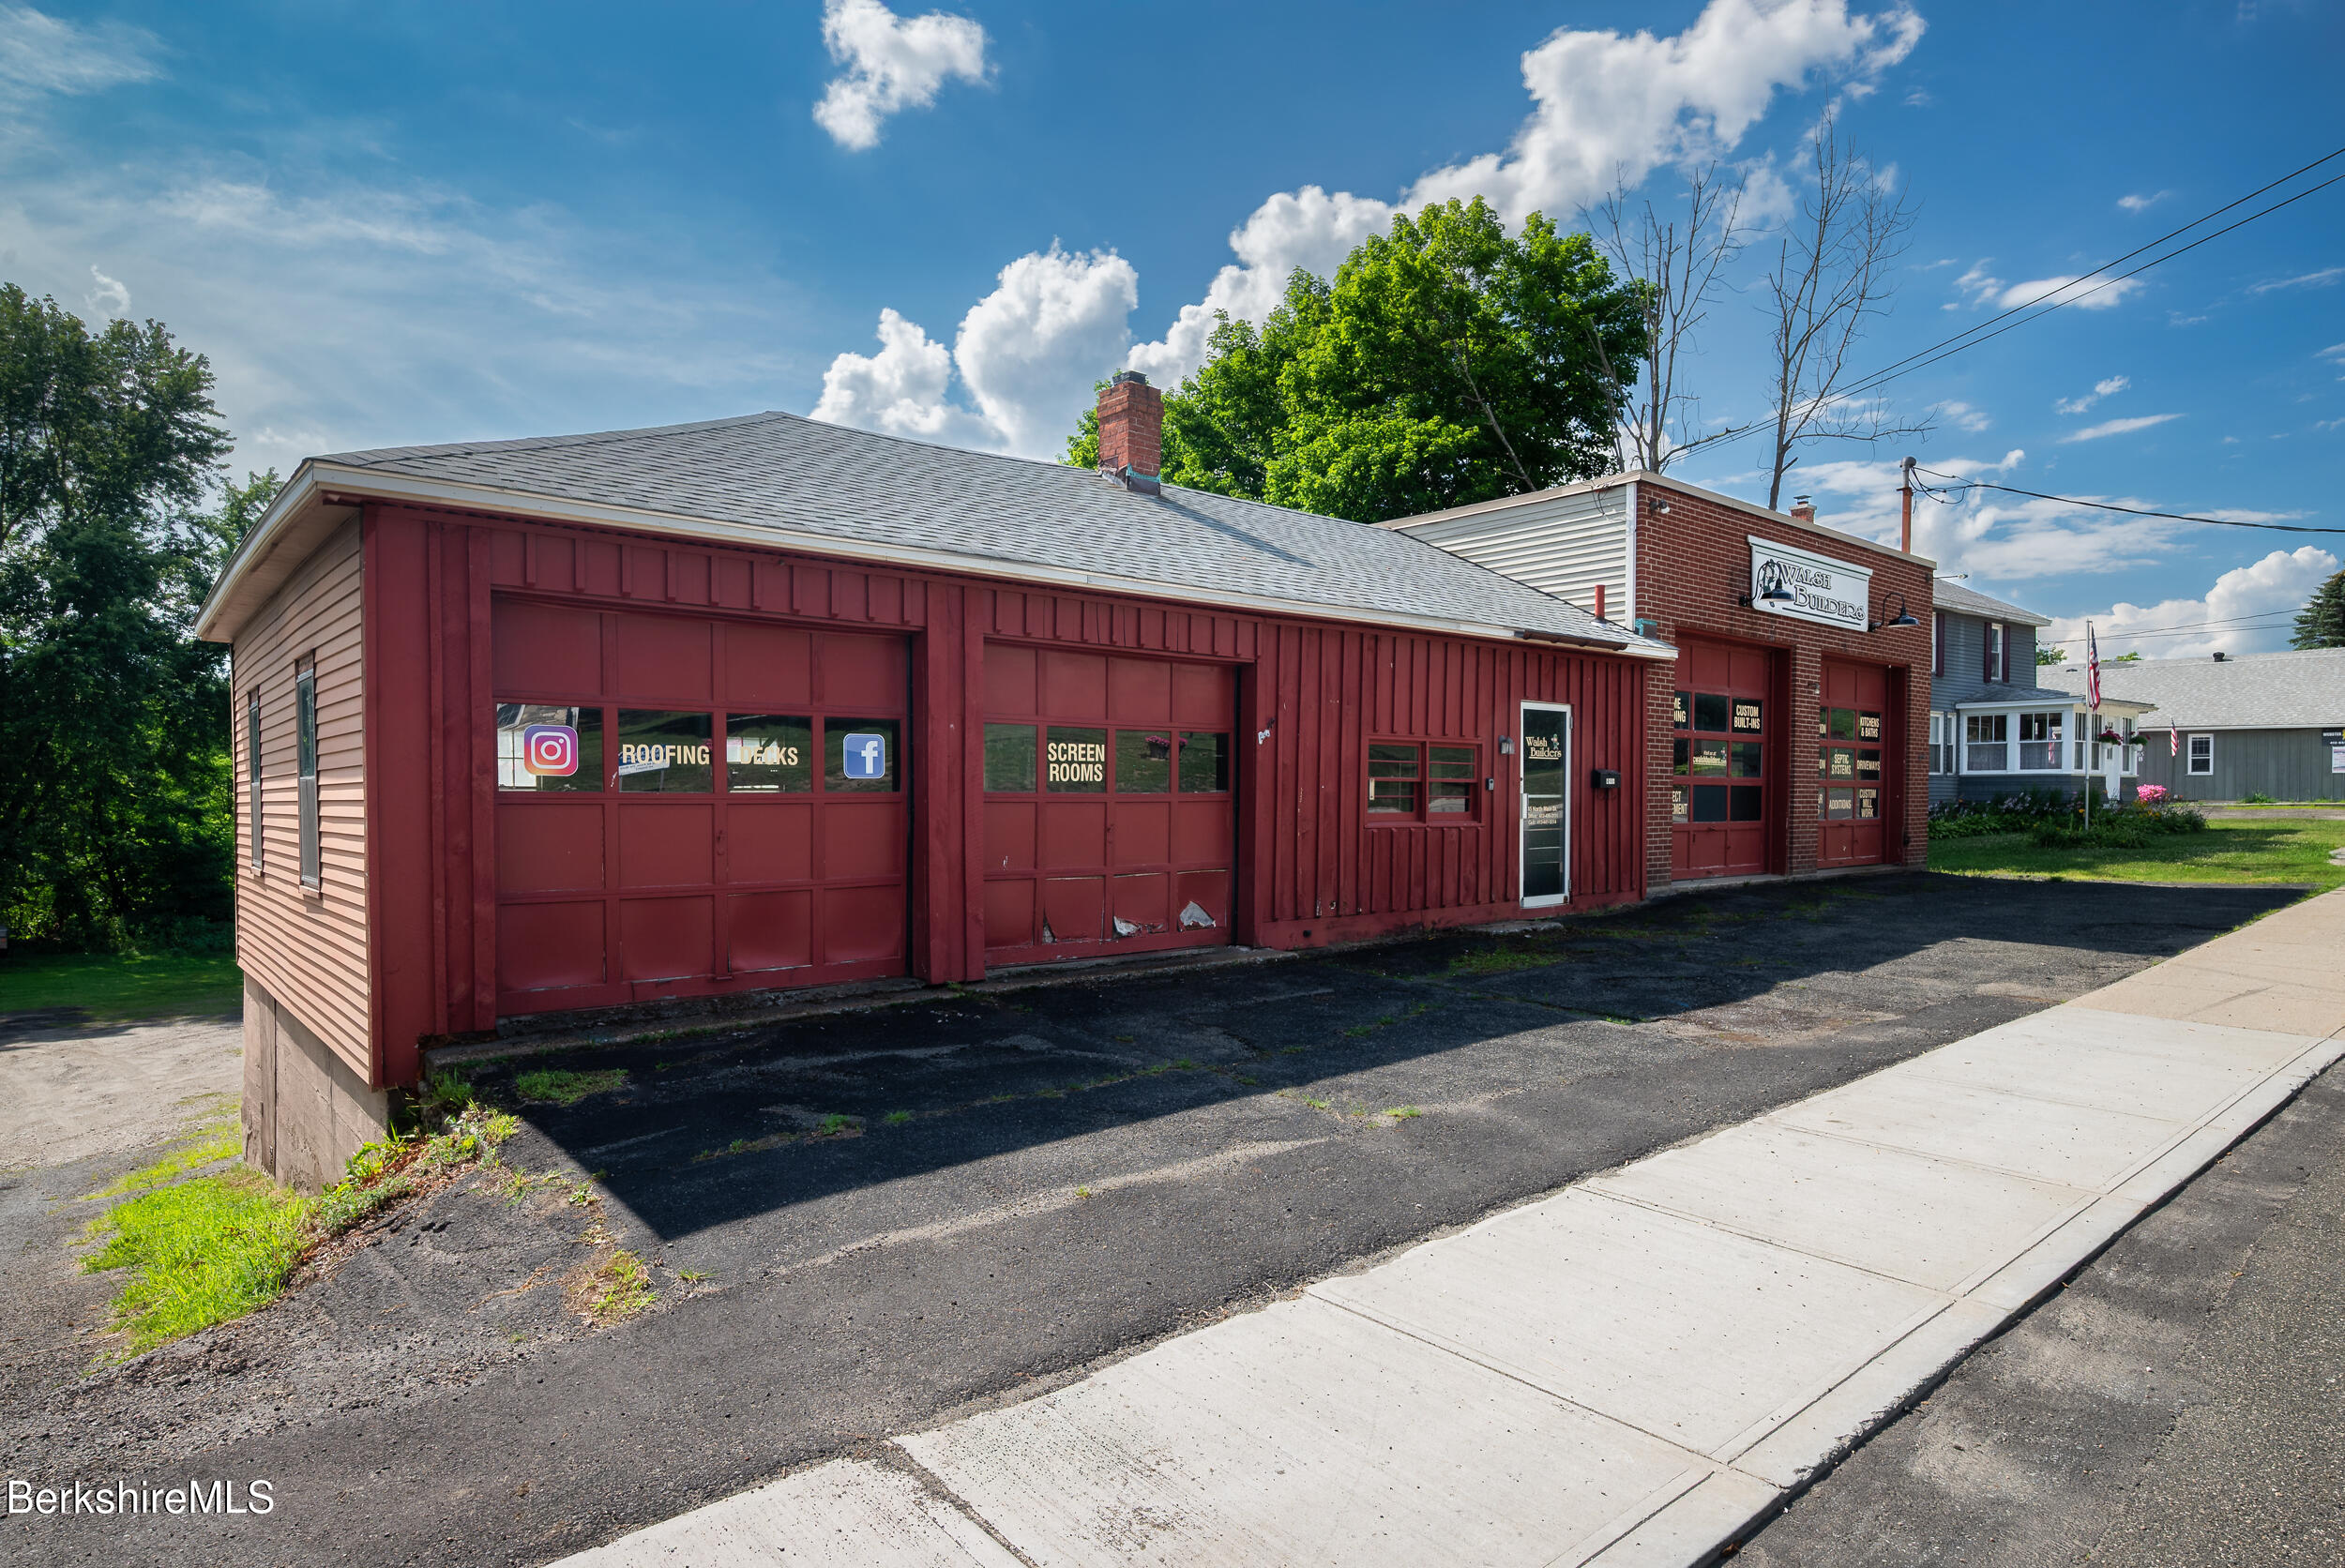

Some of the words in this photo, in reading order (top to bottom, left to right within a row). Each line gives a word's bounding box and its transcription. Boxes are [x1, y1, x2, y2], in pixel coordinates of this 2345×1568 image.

[1778, 561, 1831, 590] WALSH
[1794, 585, 1865, 621] BUILDERS
[1736, 704, 1759, 716] CUSTOM
[1733, 716, 1760, 730] BUILT-INS
[1860, 716, 1879, 728] KITCHENS
[1525, 736, 1548, 747] Walsh
[622, 744, 710, 765] ROOFING
[740, 746, 798, 765] DECKS
[1048, 743, 1105, 762] SCREEN
[1530, 746, 1562, 758] Builders
[1834, 753, 1850, 764] SEPTIC
[1831, 764, 1852, 775] SYSTEMS
[1856, 760, 1881, 771] DRIVEWAYS
[1050, 762, 1103, 782] ROOMS
[1859, 789, 1877, 799] CUSTOM
[1828, 799, 1852, 810] ADDITIONS
[1860, 807, 1874, 818] WORK
